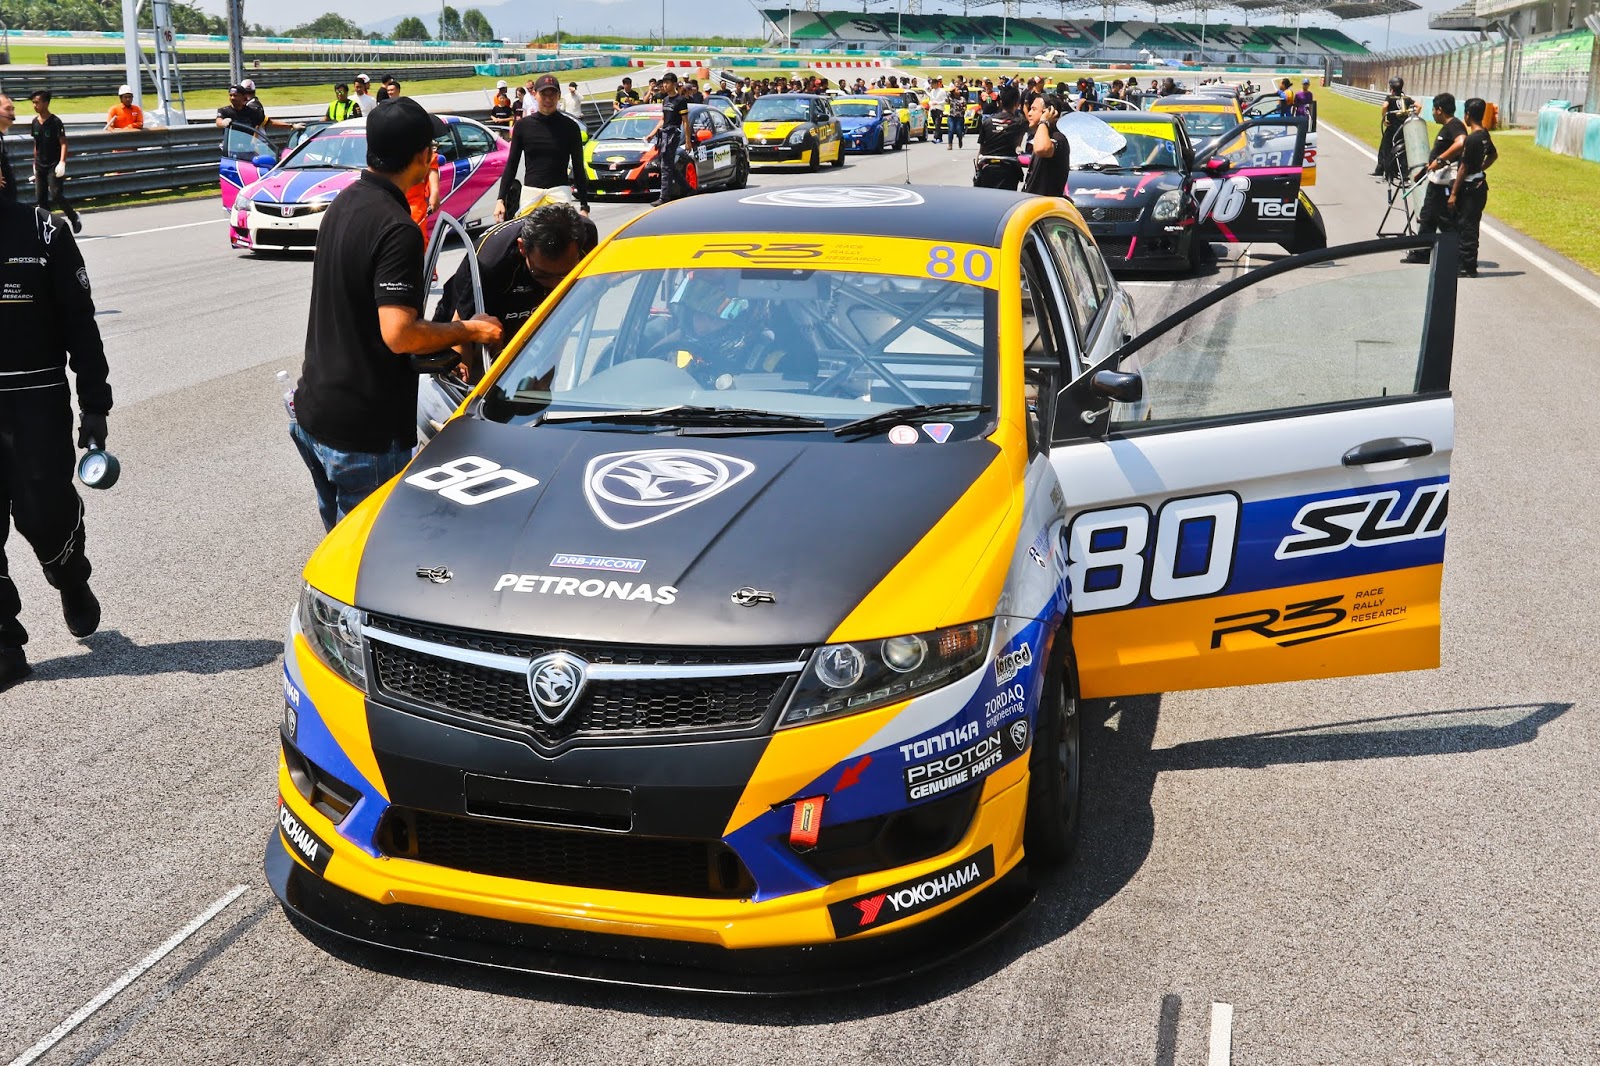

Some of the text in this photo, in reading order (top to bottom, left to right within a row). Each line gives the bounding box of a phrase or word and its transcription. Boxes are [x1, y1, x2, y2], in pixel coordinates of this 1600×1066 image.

[1190, 175, 1251, 224] 76
[926, 245, 992, 281] 80
[404, 455, 540, 506] 80
[556, 555, 640, 570] DRB-HICOM
[1068, 490, 1242, 616] 80
[493, 573, 680, 606] PETRONAS
[1352, 598, 1386, 611] RALLY
[1355, 587, 1385, 599] RACE
[1350, 606, 1407, 623] RESEARCH
[984, 683, 1025, 718] ZORDAQ
[986, 700, 1025, 729] engineering
[907, 731, 1002, 783] PROTON
[909, 750, 1003, 800] GENUINE PARTS
[886, 862, 980, 912] YOKOHAMA
